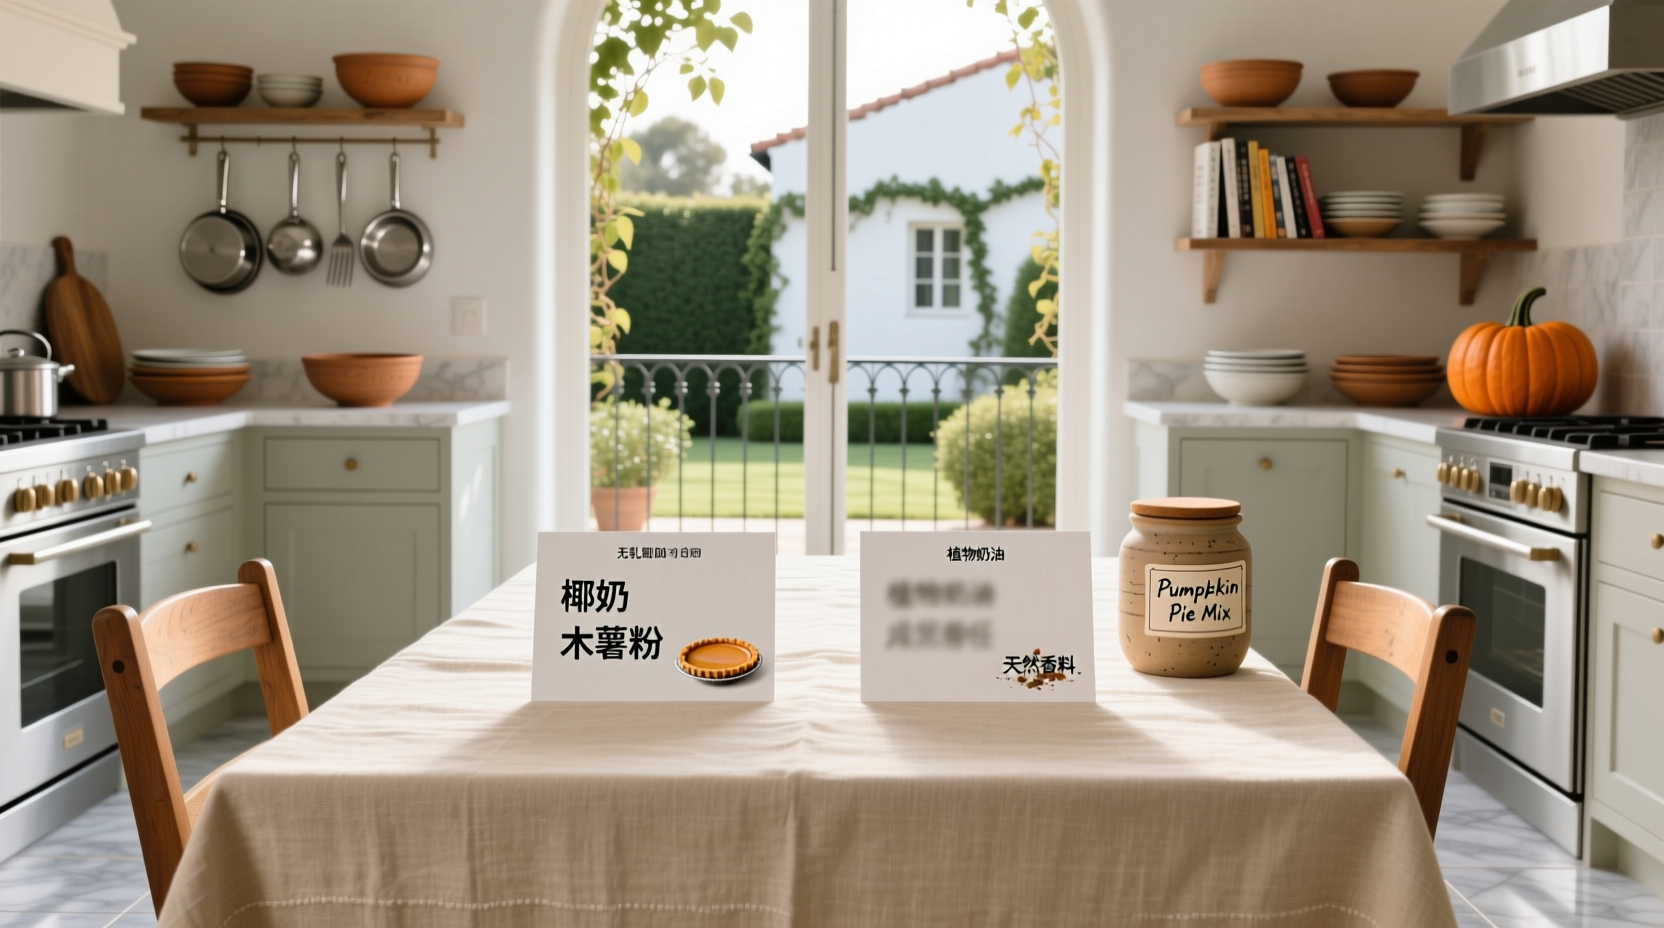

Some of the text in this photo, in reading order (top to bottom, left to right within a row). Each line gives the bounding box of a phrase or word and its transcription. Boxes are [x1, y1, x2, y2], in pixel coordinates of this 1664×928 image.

[946, 545, 1005, 562] 植物奶油
[560, 578, 629, 613] 椰奶
[1168, 602, 1231, 623] Pie Mix
[560, 625, 664, 661] 木薯粉
[1002, 654, 1076, 676] 天然香料
